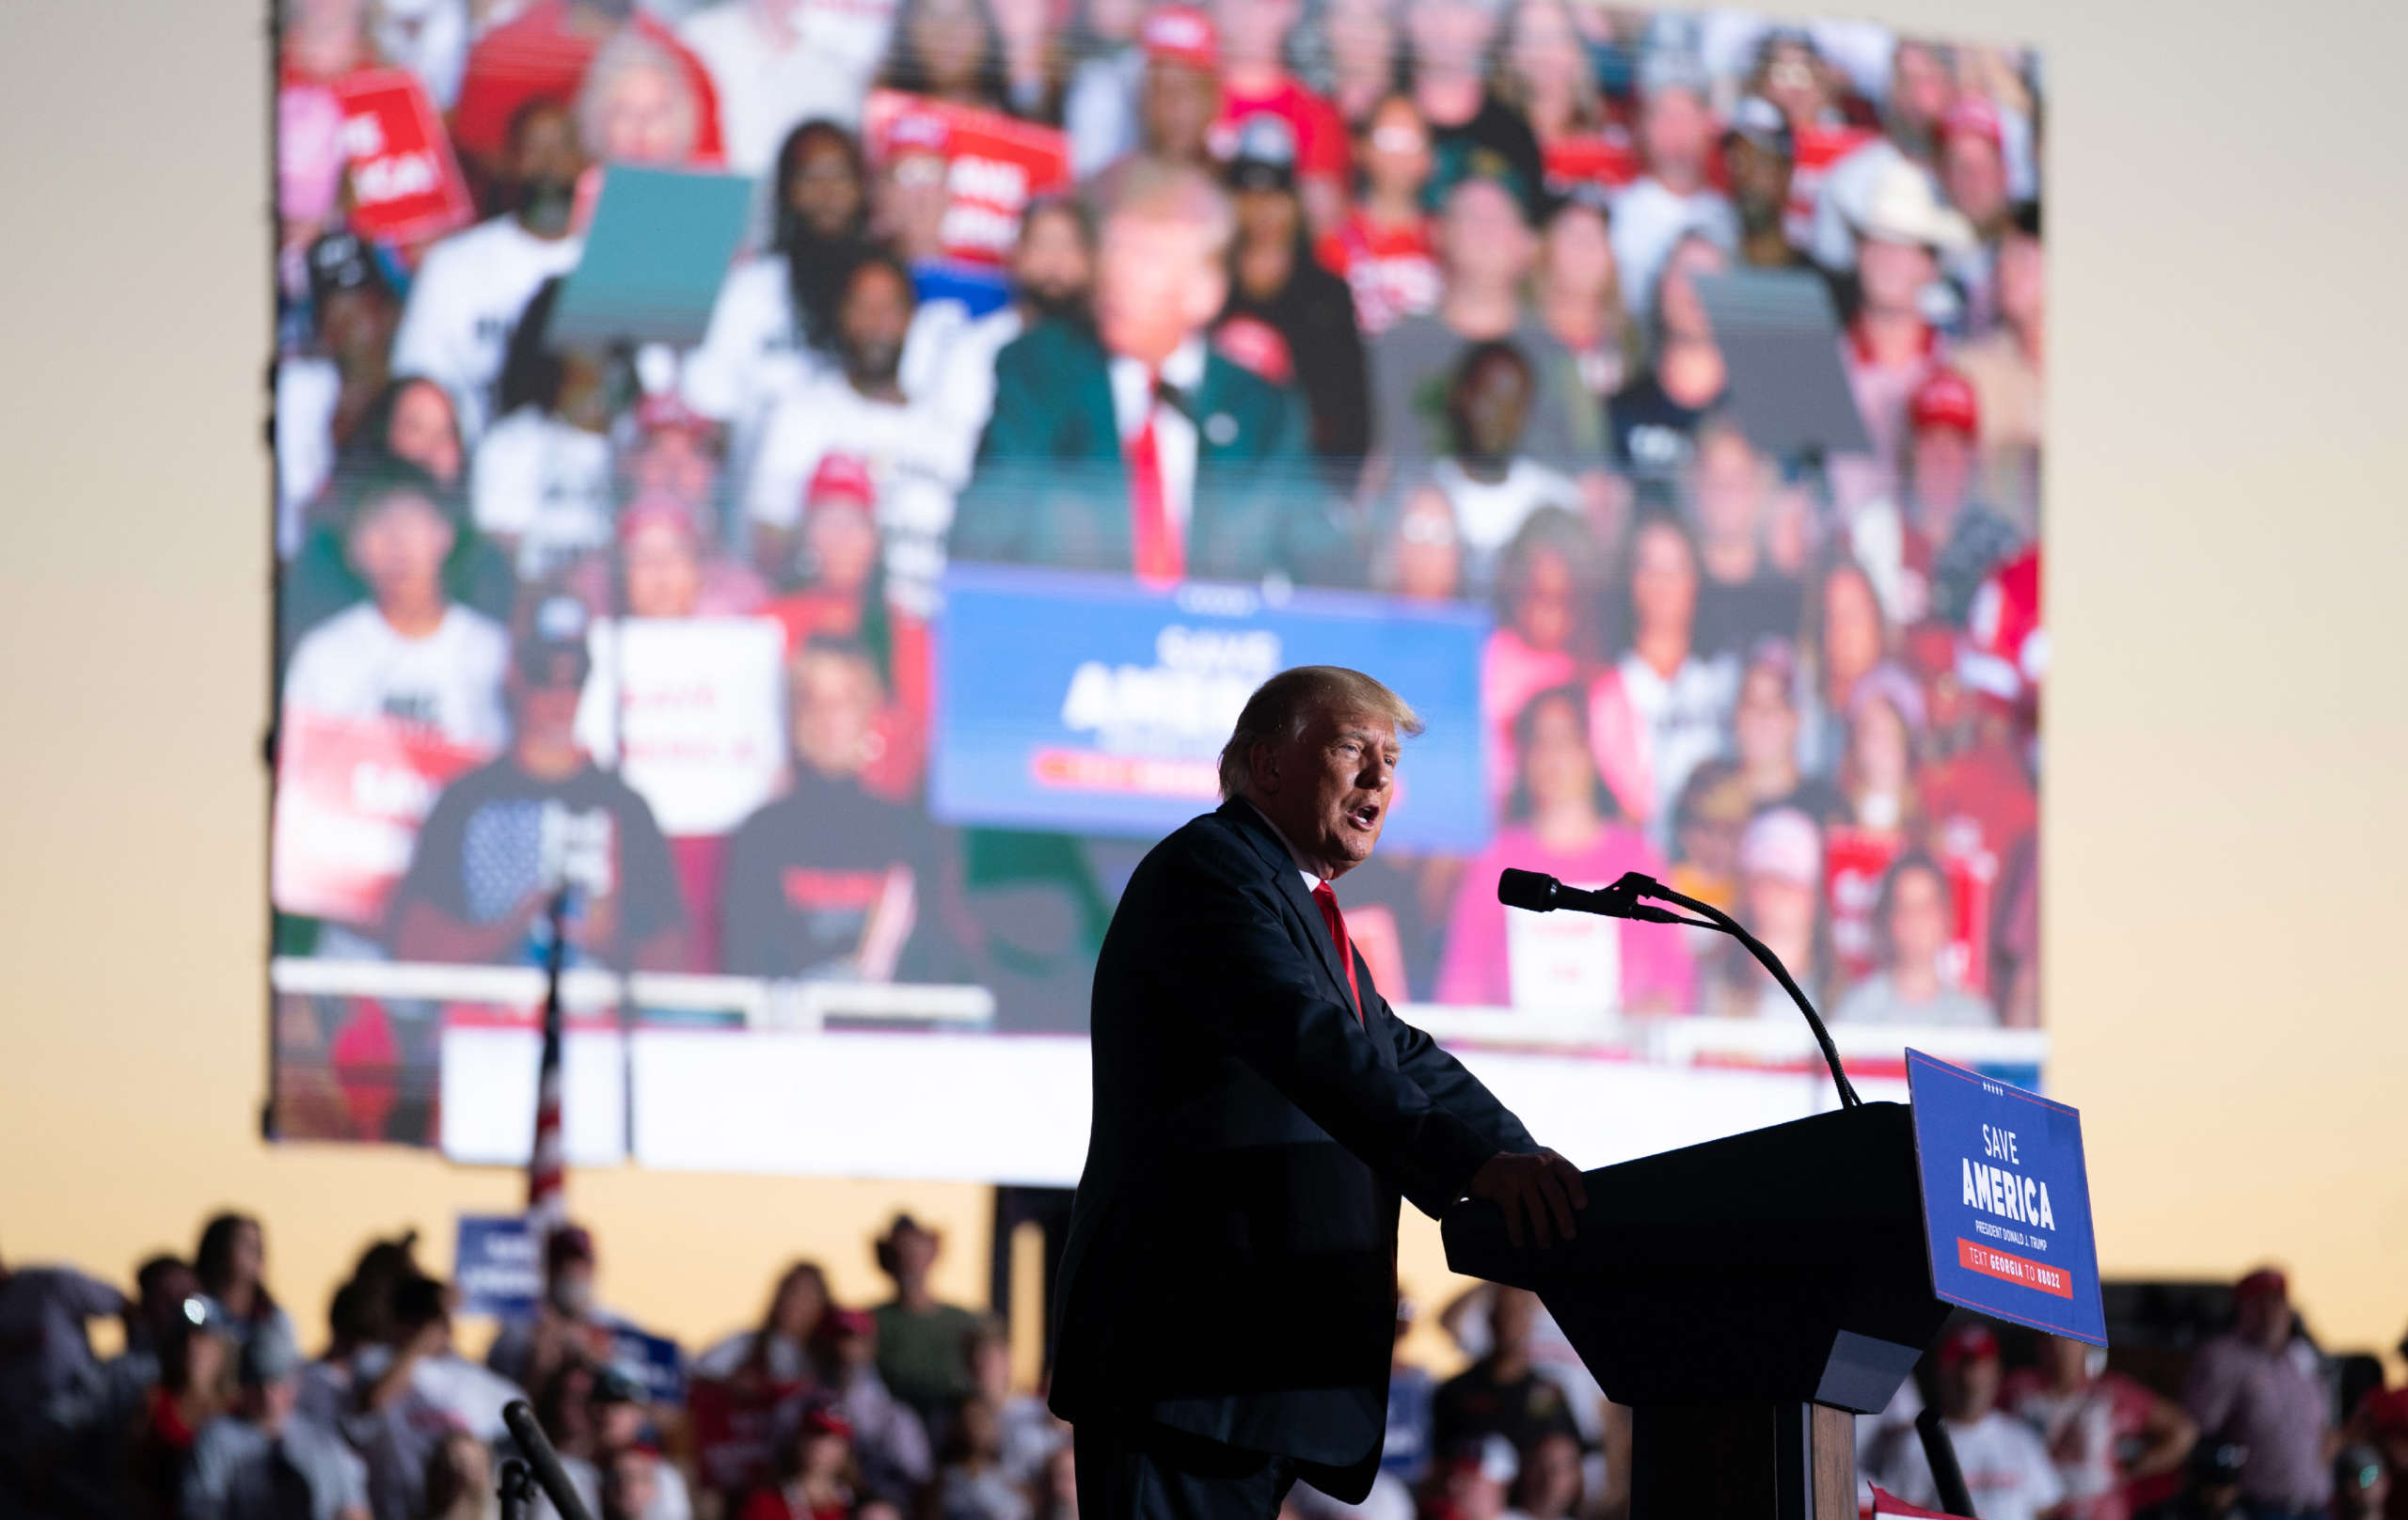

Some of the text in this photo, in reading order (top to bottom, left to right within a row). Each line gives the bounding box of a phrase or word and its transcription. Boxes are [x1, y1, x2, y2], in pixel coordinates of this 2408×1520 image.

[1982, 1123, 2020, 1165] SAVE
[1962, 1157, 2055, 1231] AMERICA
[1974, 1219, 2003, 1240] PRESIDENT
[2003, 1227, 2025, 1246] DONALD
[2029, 1235, 2048, 1252] TRUMP
[1969, 1246, 2061, 1290] TEXT GEORGIA TO 88022
